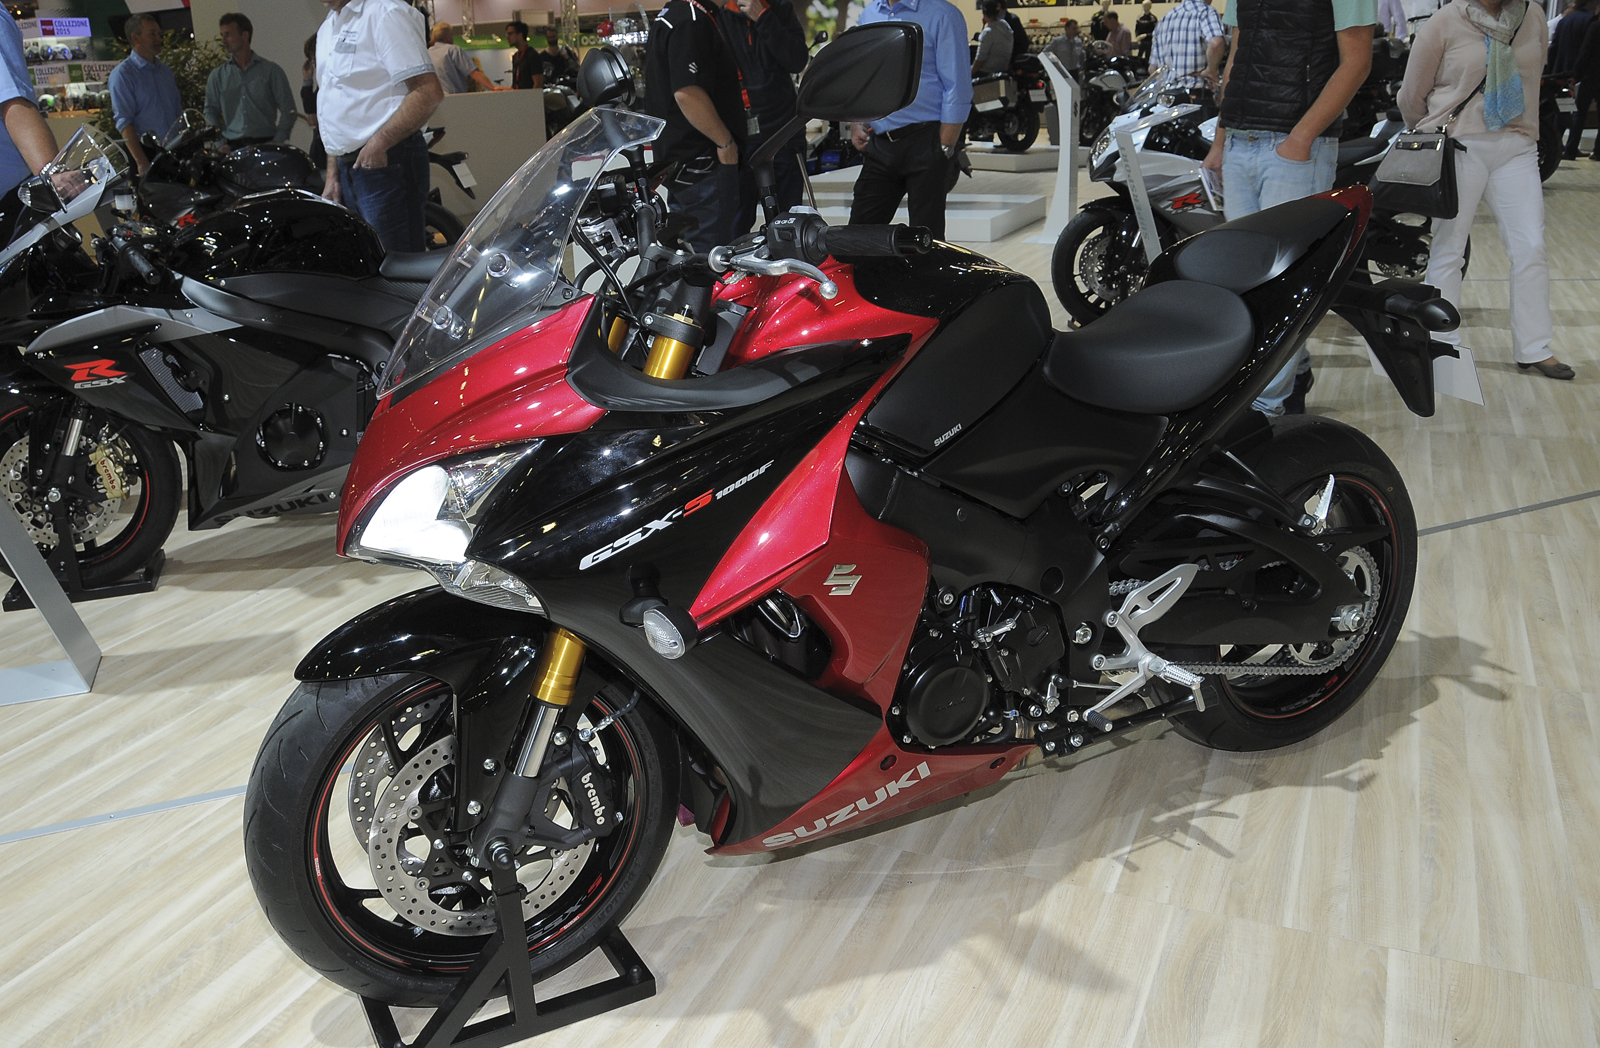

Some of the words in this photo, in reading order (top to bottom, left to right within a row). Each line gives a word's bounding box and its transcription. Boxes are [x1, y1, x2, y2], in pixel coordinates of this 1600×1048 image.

[54, 20, 88, 28] COLLEZIONE
[56, 28, 71, 36] 2015
[74, 375, 129, 390] GSX
[933, 422, 962, 448] SUZUKI
[100, 459, 116, 490] brembo
[213, 493, 330, 526] SUZUKI
[579, 488, 714, 570] GSX-S
[715, 459, 775, 500] 1000F
[581, 771, 606, 826] brembo
[762, 760, 931, 848] SUZUKI
